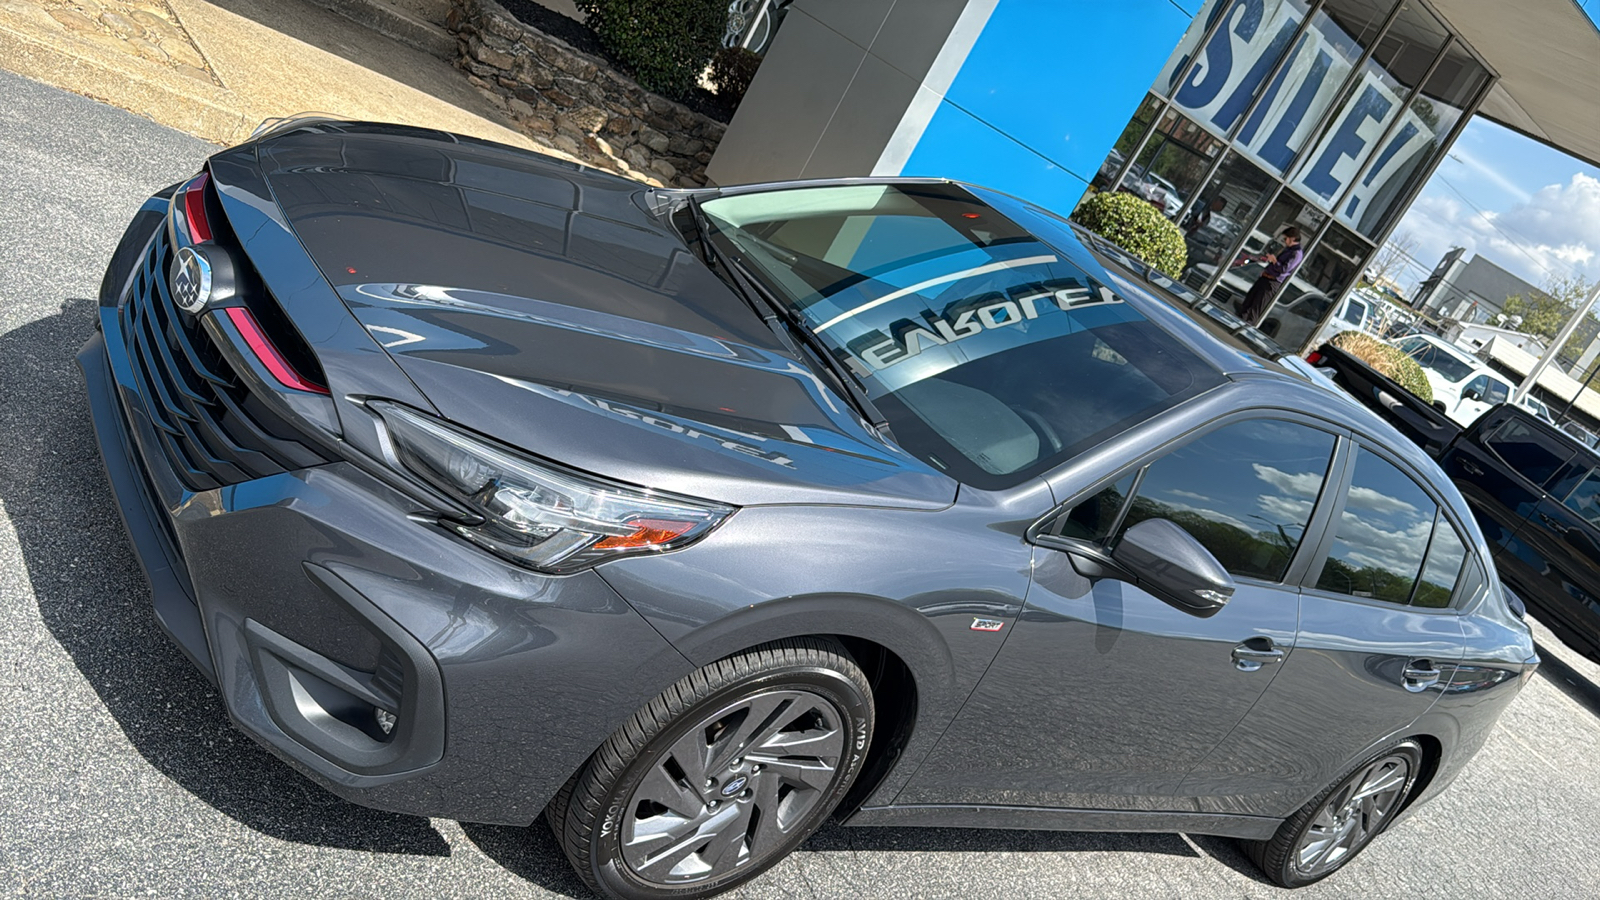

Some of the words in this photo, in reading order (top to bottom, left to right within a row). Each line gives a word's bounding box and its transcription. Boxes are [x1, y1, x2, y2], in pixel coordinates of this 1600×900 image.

[1169, 0, 1420, 220] SALE!
[973, 620, 1002, 629] SPORT
[855, 717, 867, 750] AVID
